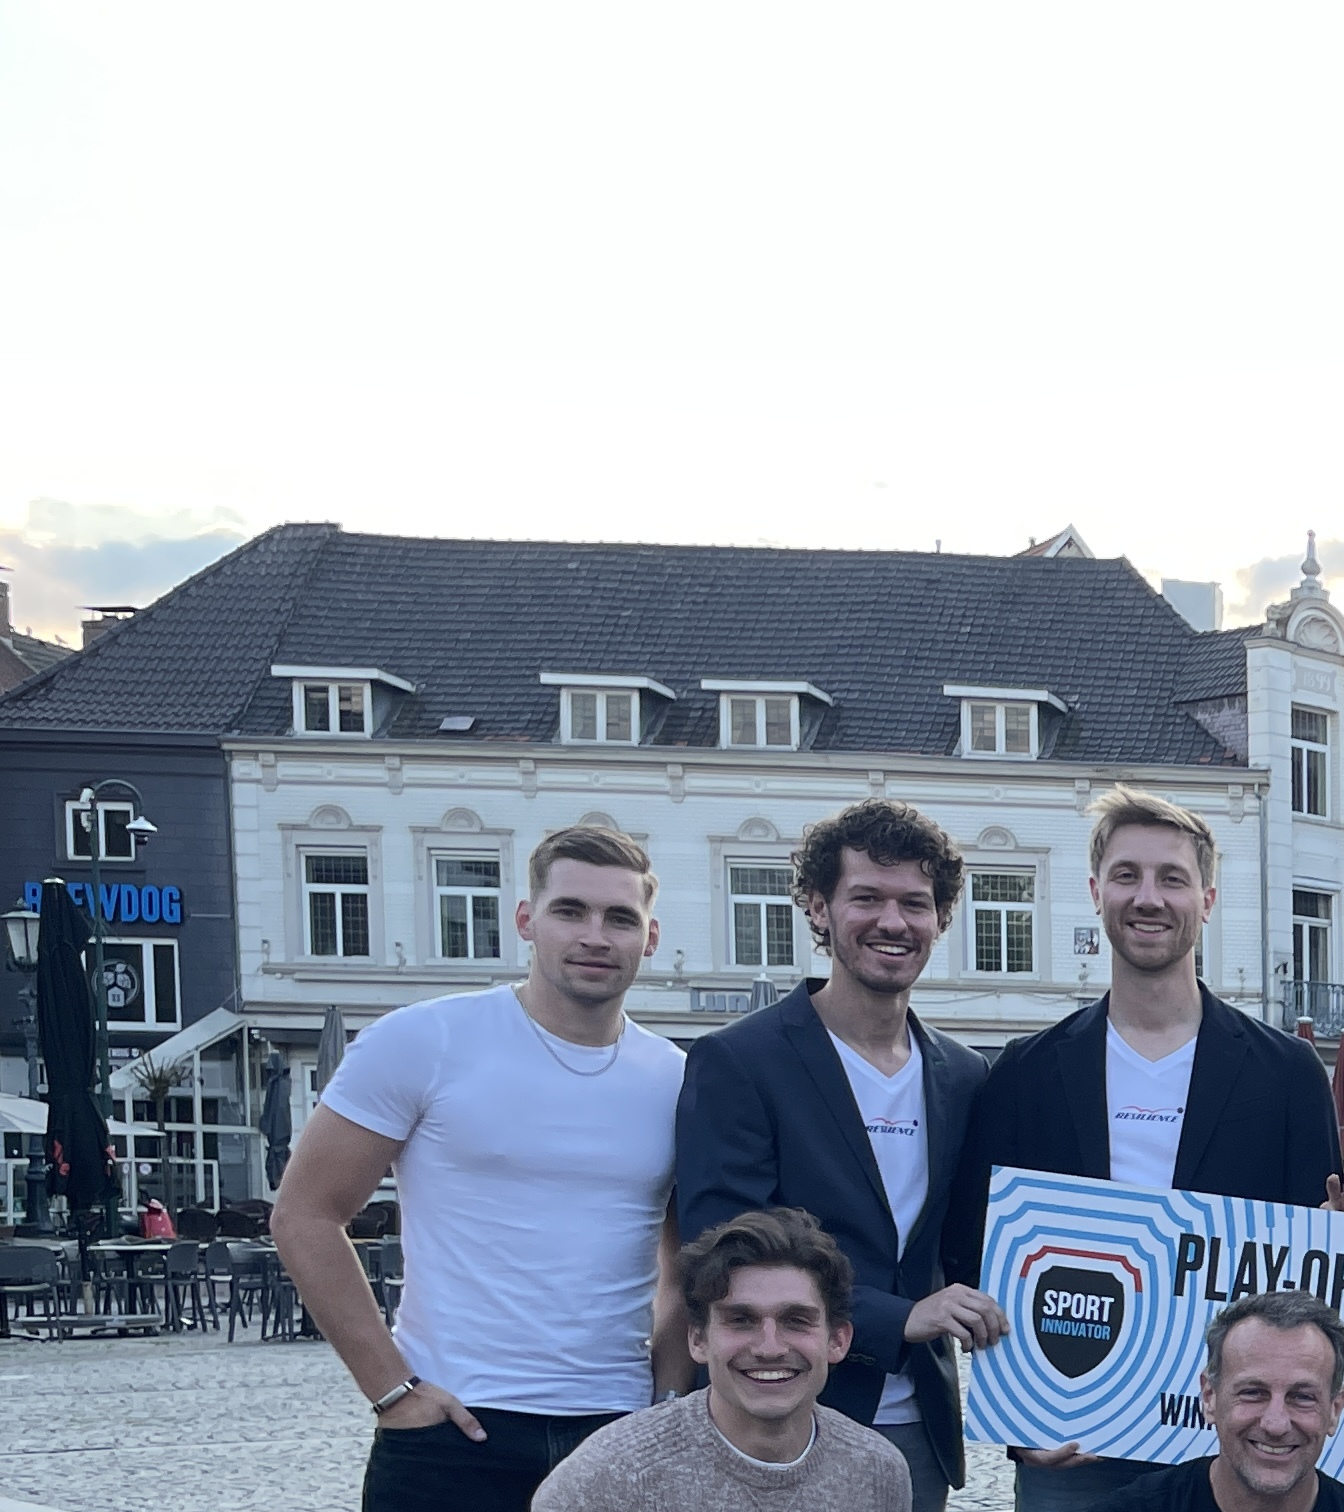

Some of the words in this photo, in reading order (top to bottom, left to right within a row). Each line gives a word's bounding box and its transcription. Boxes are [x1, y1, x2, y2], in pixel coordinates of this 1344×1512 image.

[24, 881, 182, 923] BEWDOG
[1042, 1289, 1116, 1323] SPORT
[1040, 1317, 1112, 1342] INNOVATOR
